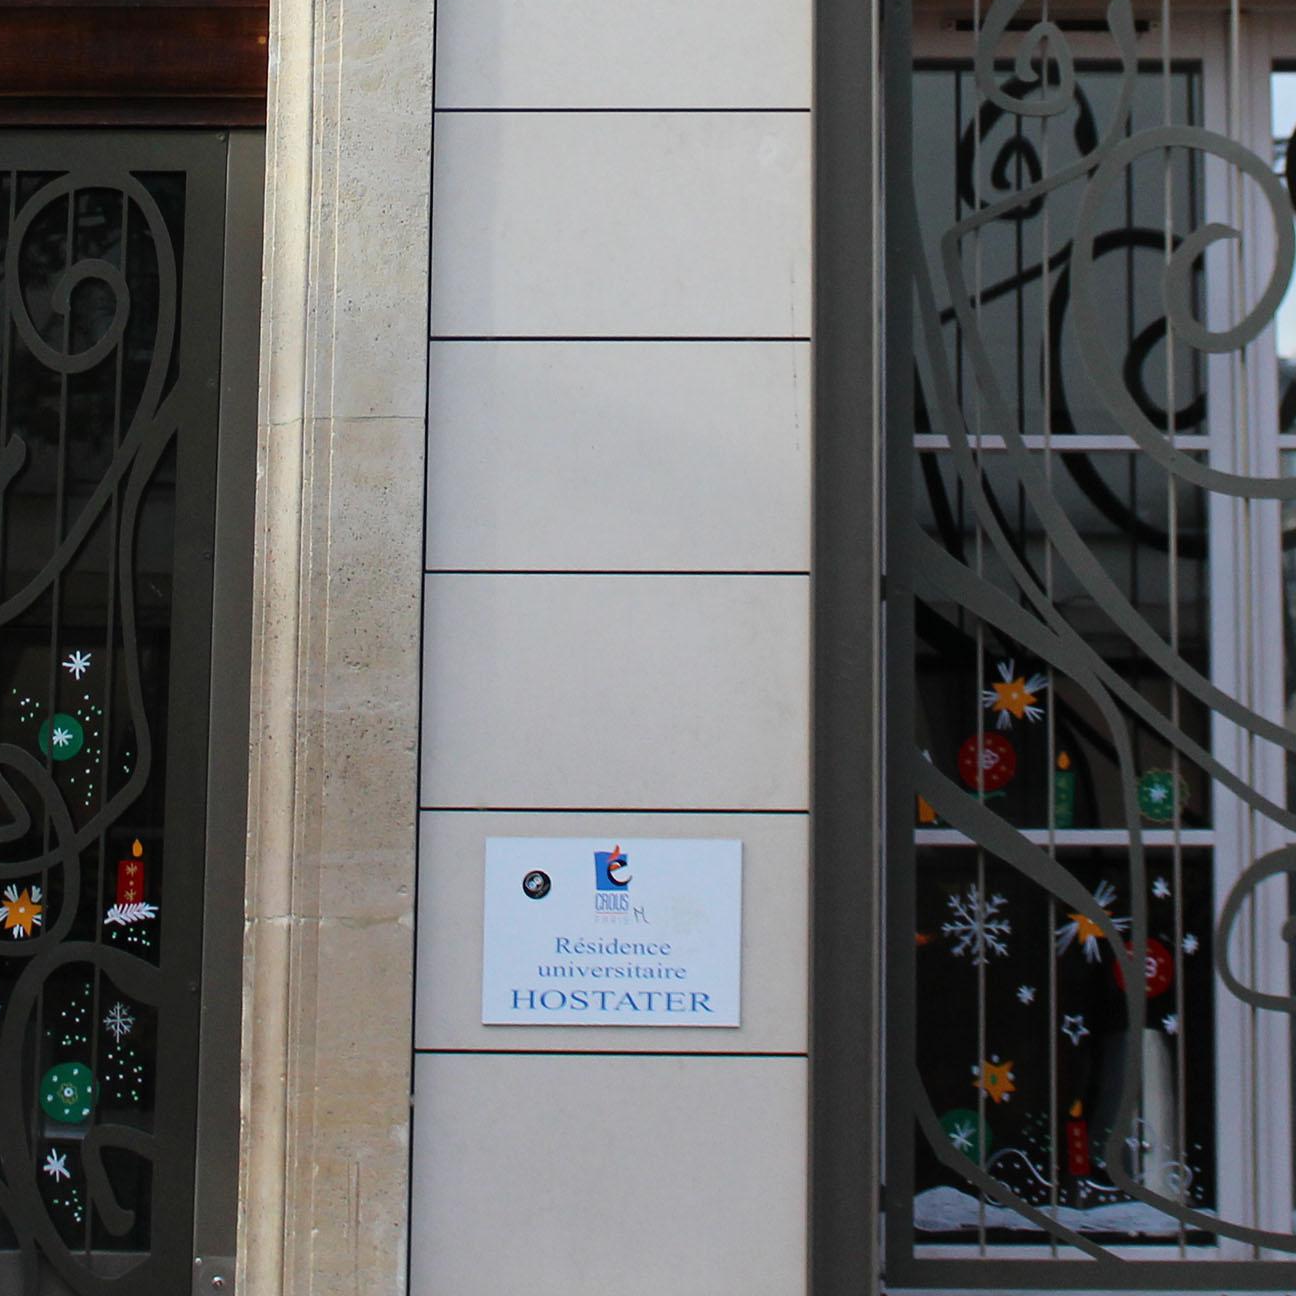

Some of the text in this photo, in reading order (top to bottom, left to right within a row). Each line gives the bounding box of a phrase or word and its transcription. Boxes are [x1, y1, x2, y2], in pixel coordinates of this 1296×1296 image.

[555, 936, 672, 956] Résidence
[538, 961, 687, 980] universitaire
[512, 989, 714, 1013] HOSTATER
